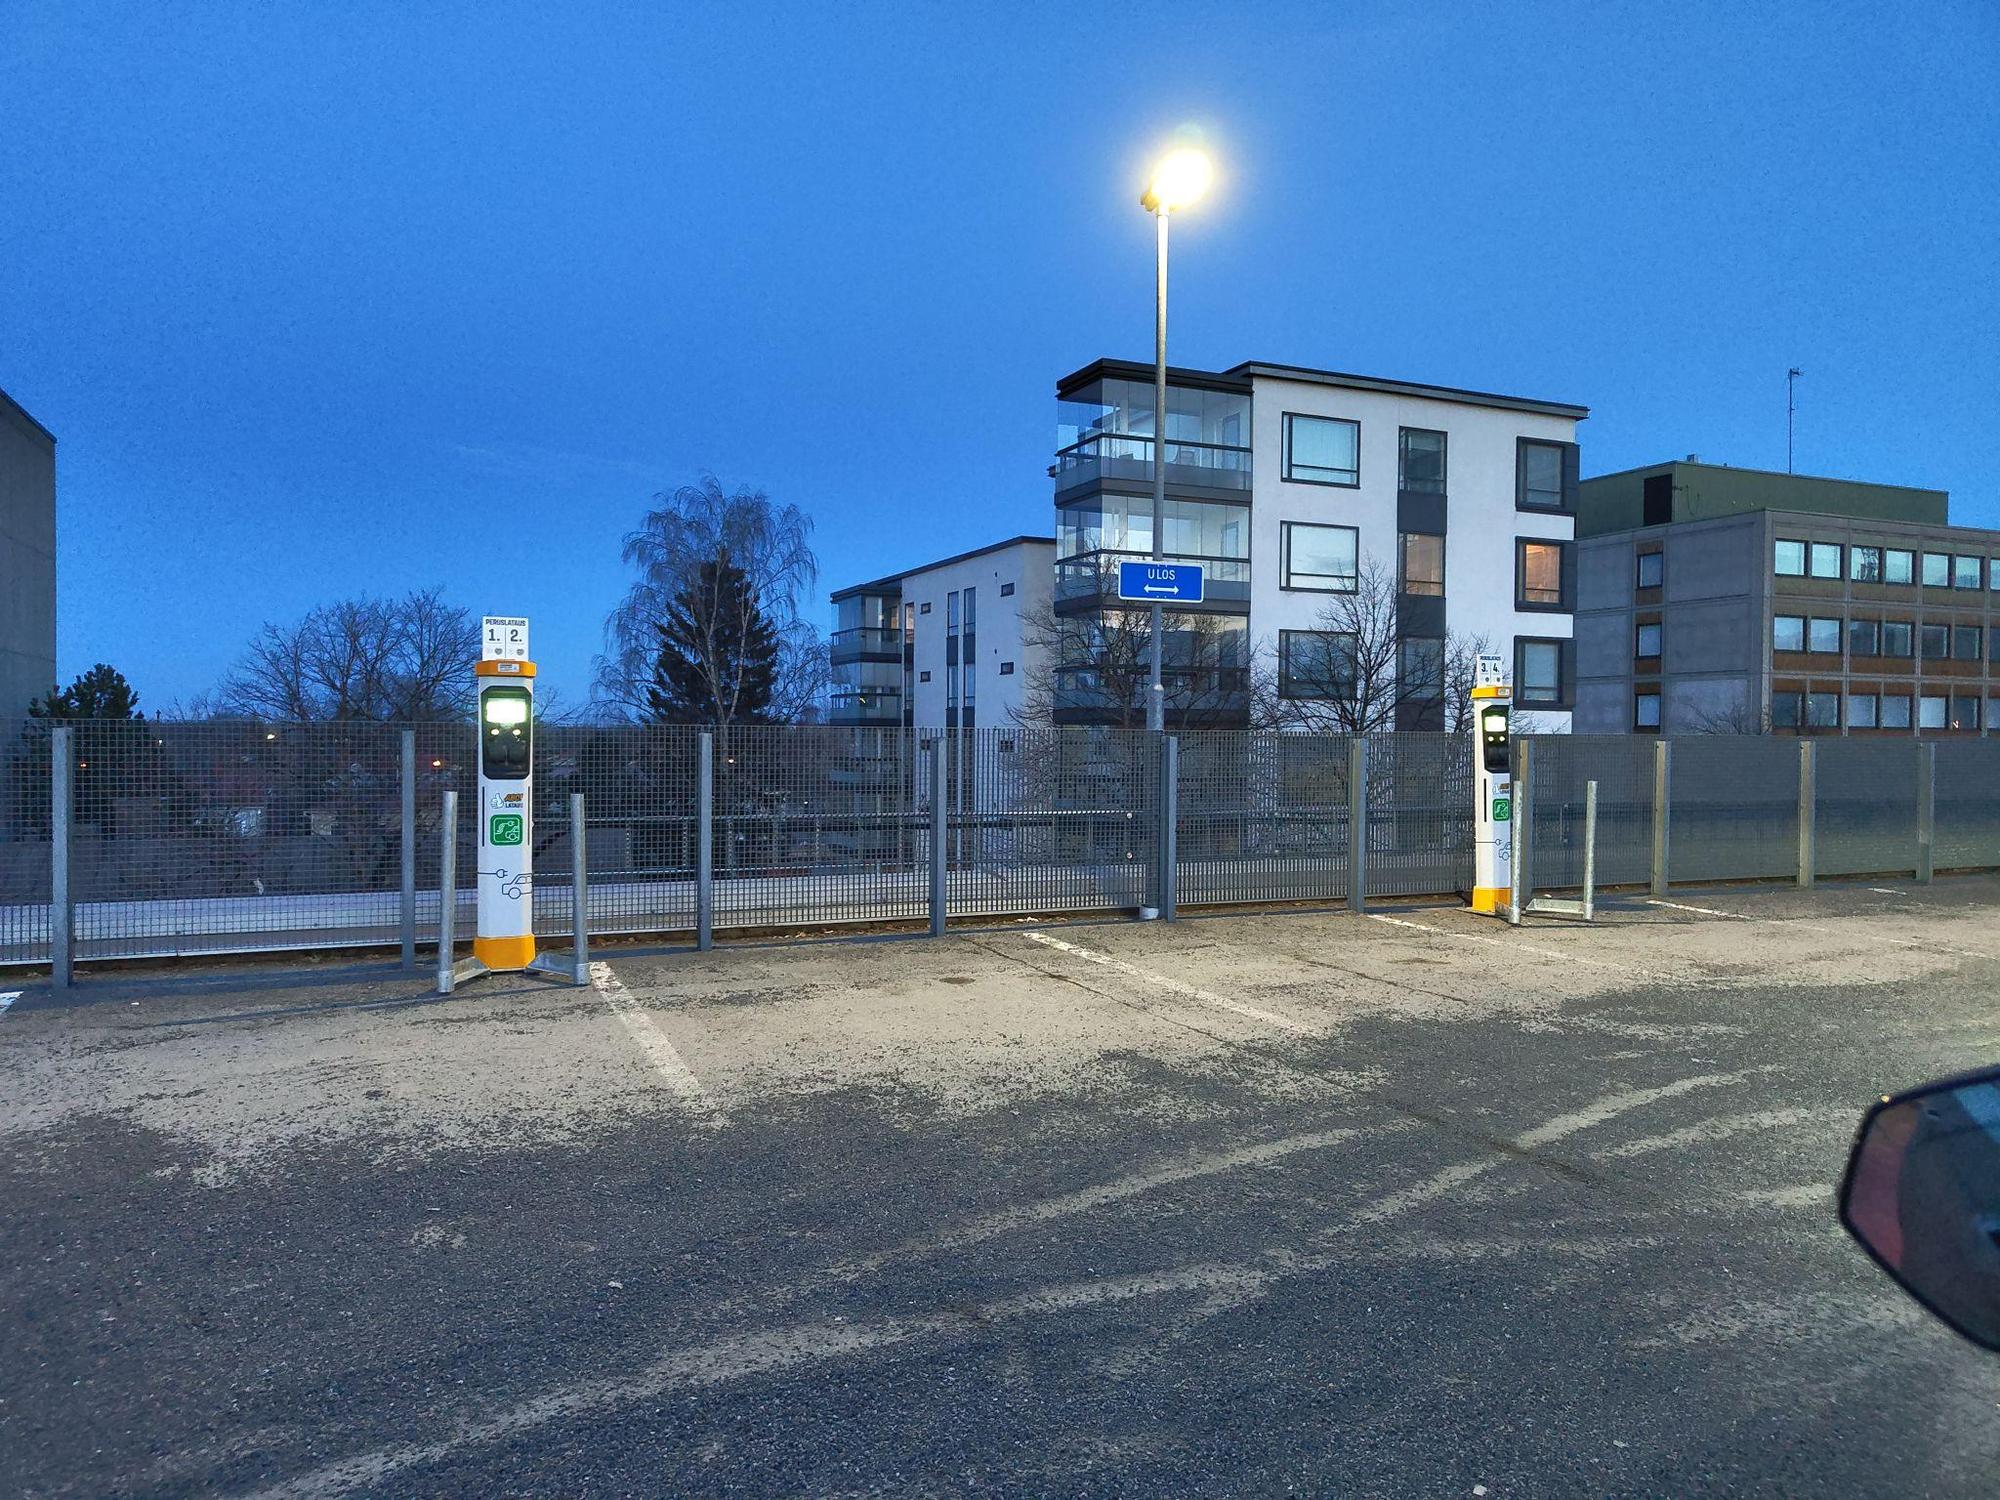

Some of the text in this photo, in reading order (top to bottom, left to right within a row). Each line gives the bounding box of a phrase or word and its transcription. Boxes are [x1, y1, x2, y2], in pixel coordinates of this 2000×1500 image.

[1148, 568, 1176, 580] ULOS
[488, 628, 522, 642] 1. 2.
